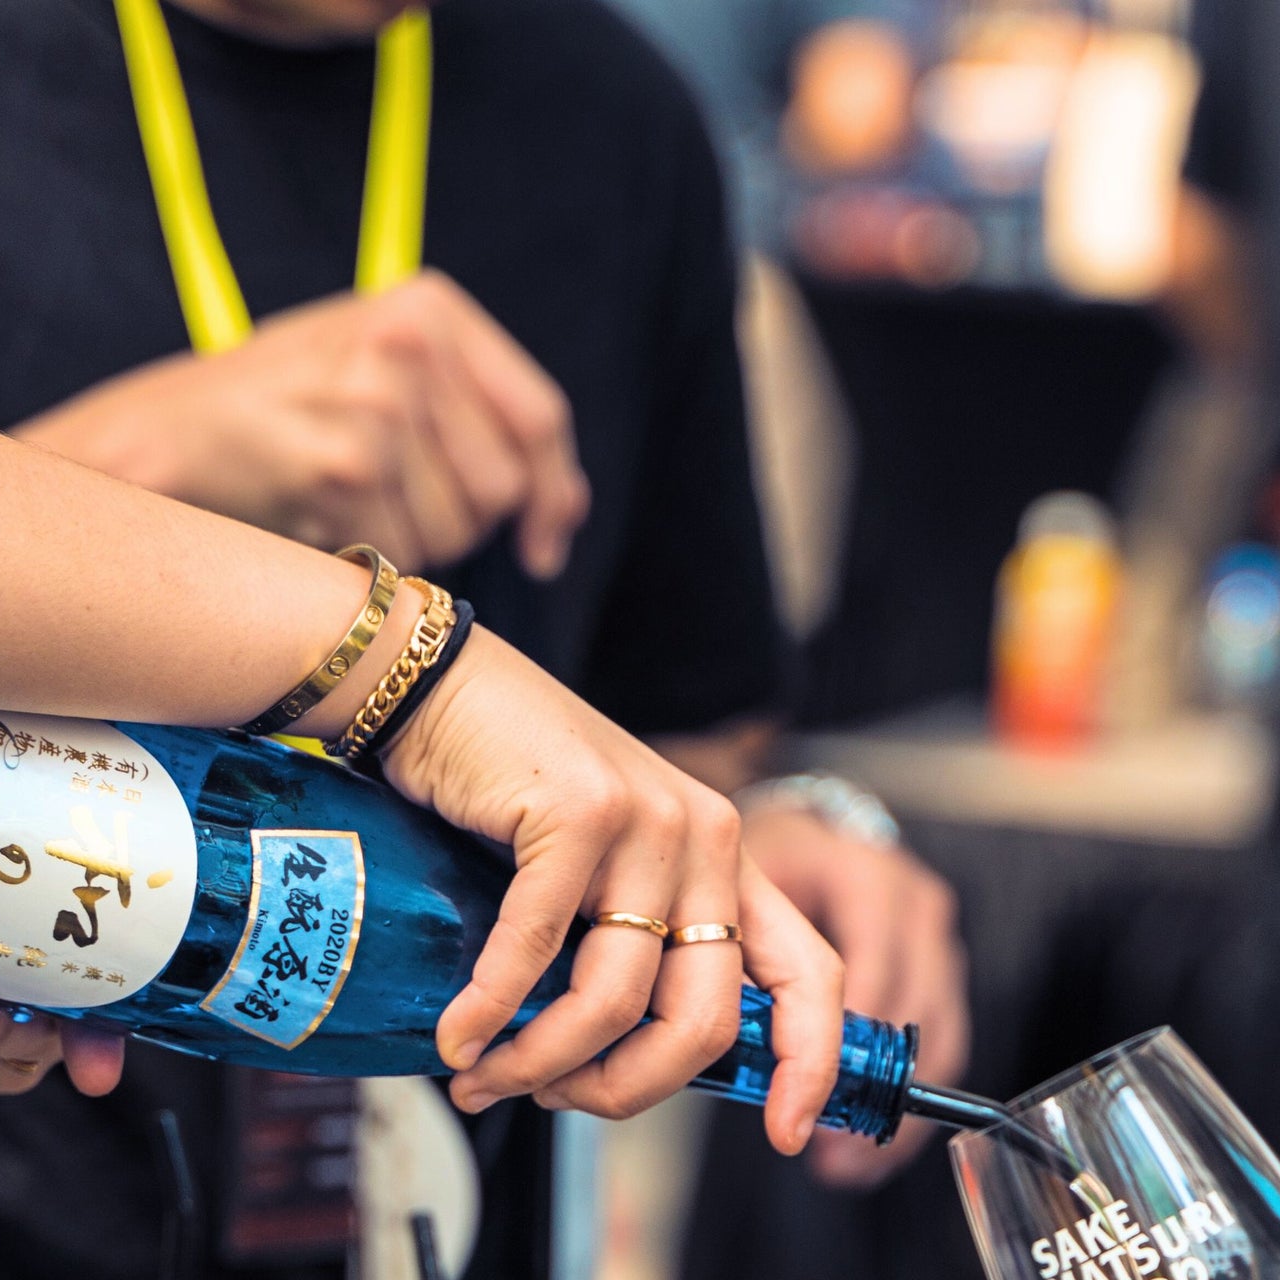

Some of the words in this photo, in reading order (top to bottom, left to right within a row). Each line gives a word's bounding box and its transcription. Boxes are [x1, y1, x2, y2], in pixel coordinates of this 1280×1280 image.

[71, 771, 144, 802] 日本酒
[249, 908, 270, 951] Kimoto
[310, 908, 350, 994] 2020BY
[1031, 1199, 1141, 1280] SAKE
